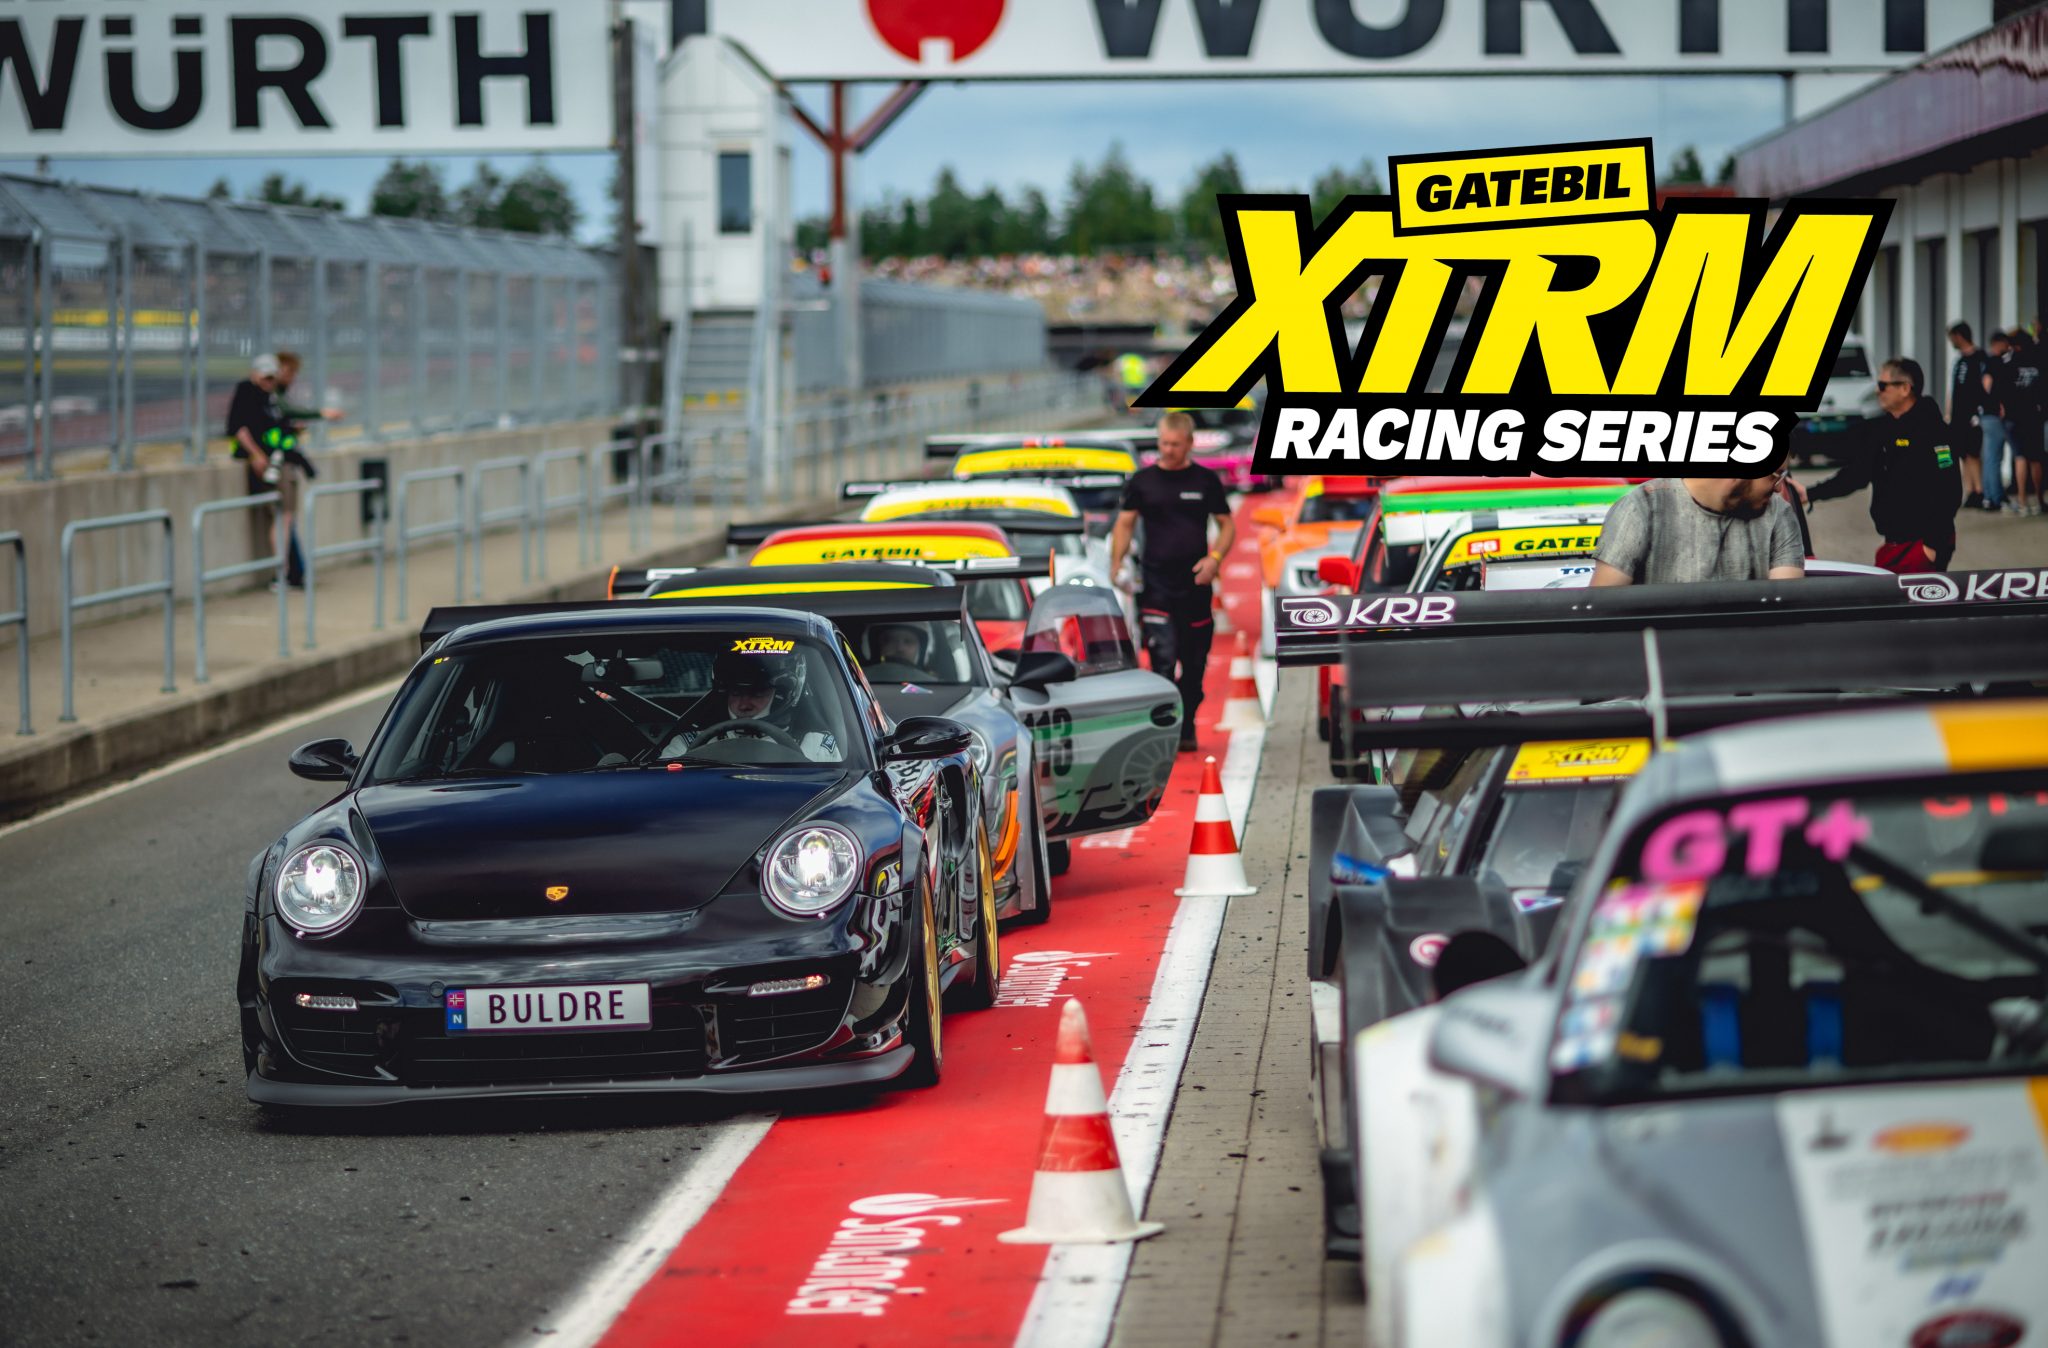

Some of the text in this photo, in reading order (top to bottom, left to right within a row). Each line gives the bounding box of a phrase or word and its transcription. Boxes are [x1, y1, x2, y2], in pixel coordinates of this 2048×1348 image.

[1513, 536, 1600, 552] GATE
[1344, 596, 1457, 625] KRB
[731, 640, 795, 651] XTRM
[1641, 797, 1870, 882] GT+
[488, 990, 625, 1024] BULDRE
[452, 1014, 462, 1024] N
